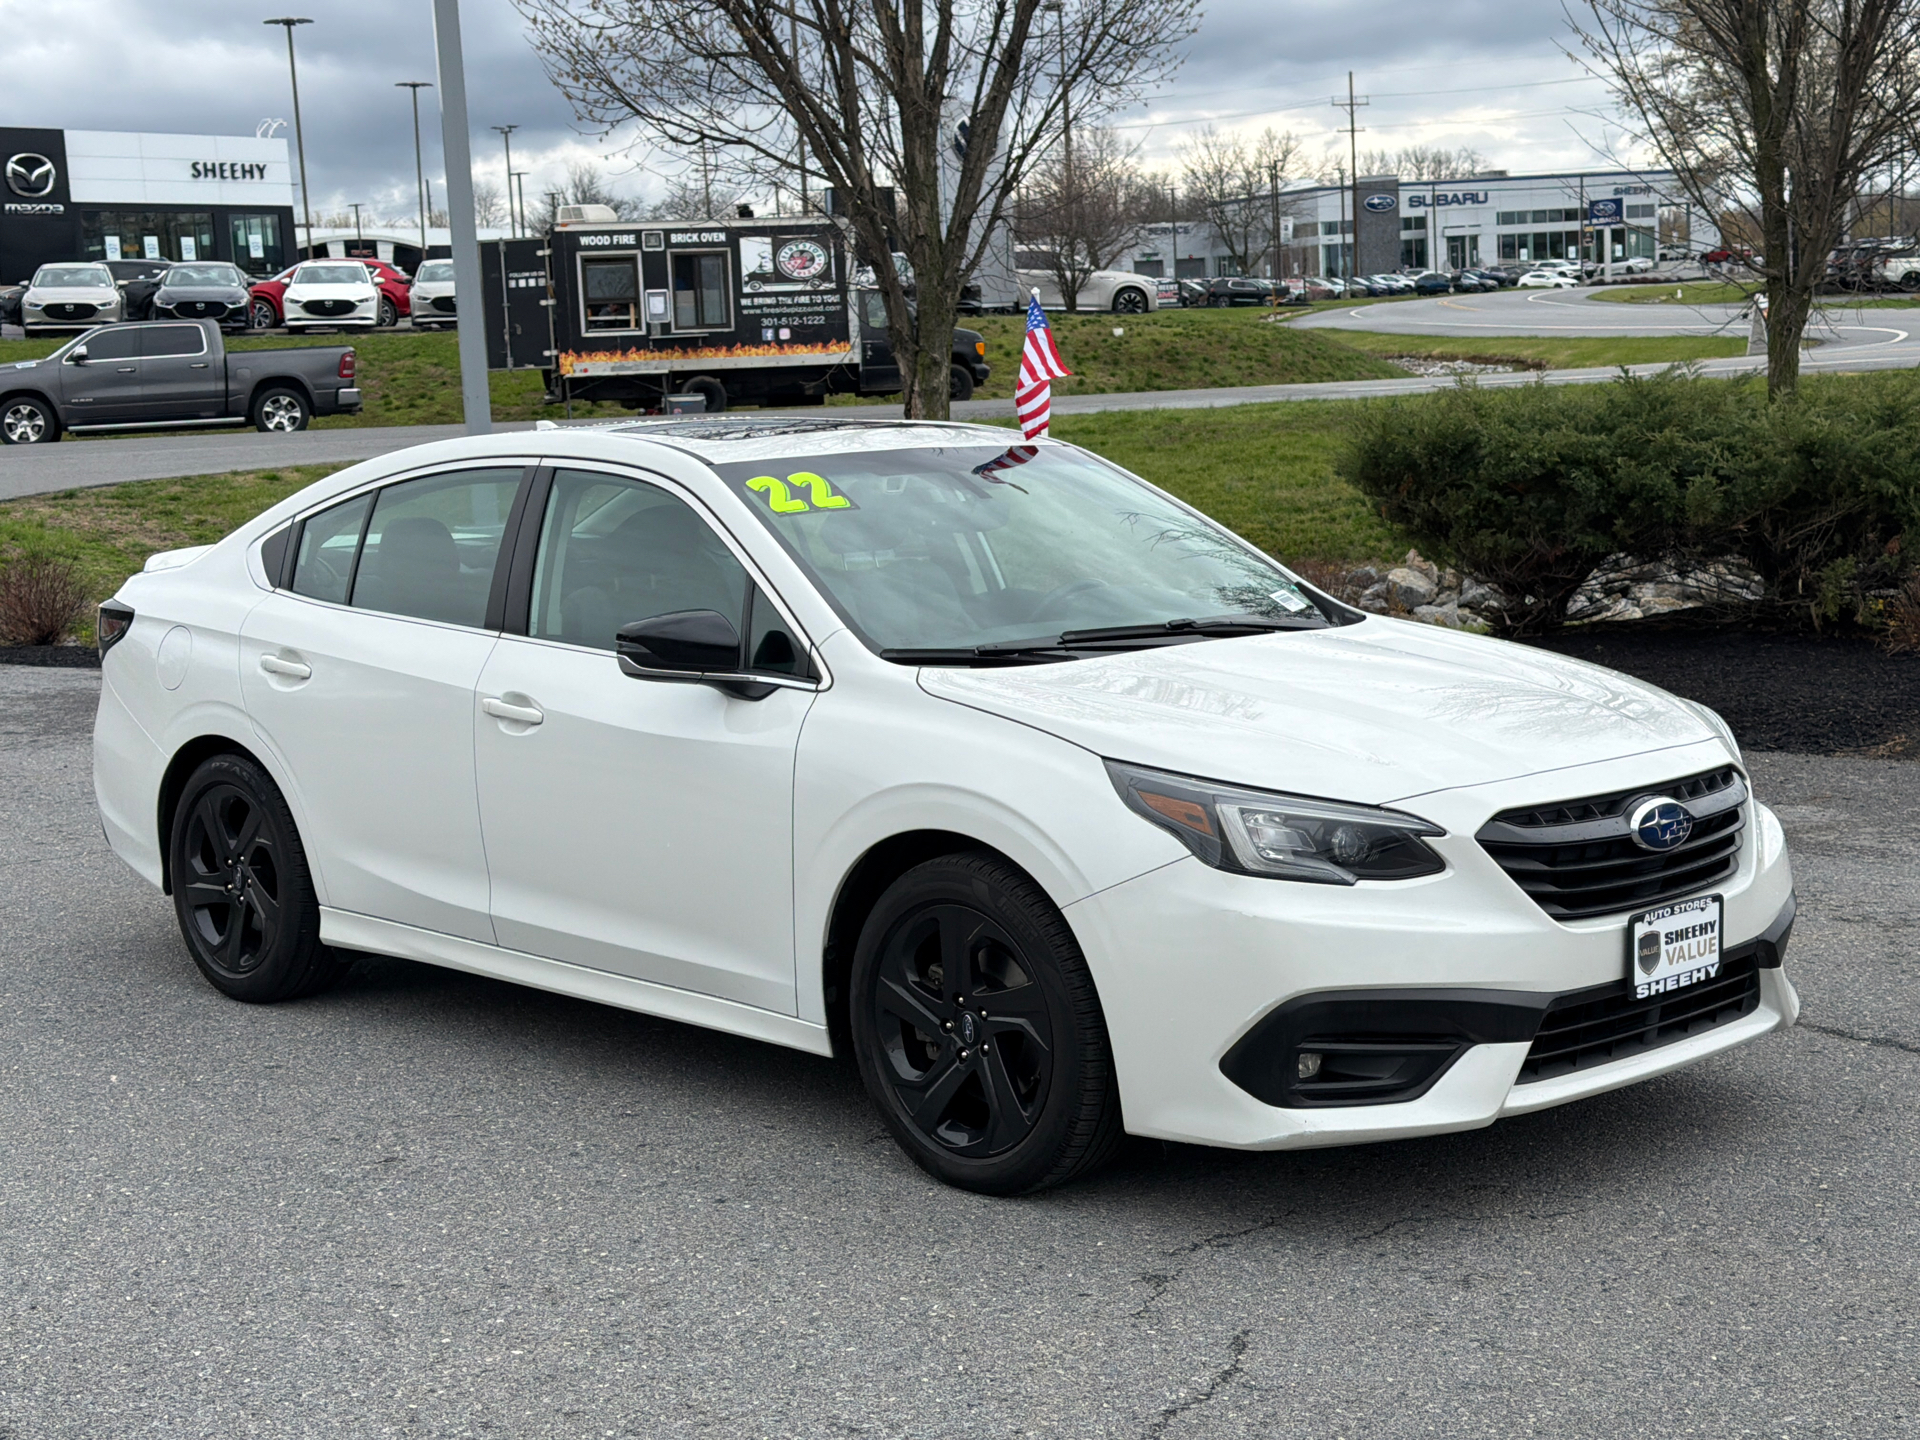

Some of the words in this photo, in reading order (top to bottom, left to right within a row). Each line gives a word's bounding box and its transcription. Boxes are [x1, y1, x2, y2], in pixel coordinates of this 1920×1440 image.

[191, 161, 267, 180] SHEEHY
[1408, 192, 1488, 208] SUBARU
[579, 236, 610, 246] WOOD
[613, 234, 636, 245] FIRE
[670, 233, 699, 243] BRICK
[701, 232, 726, 243] OVEN
[740, 298, 752, 306] WE
[753, 297, 777, 305] BRING
[811, 295, 822, 303] TO
[761, 316, 826, 326] 301-512-1222
[745, 471, 851, 513] 22
[1643, 908, 1671, 923] AUTO
[1673, 897, 1713, 915] STORES
[1664, 919, 1717, 946] SHEEHY
[1640, 945, 1660, 957] VALUE
[1665, 936, 1717, 966] VALUE
[1636, 962, 1720, 999] SHEEHY
